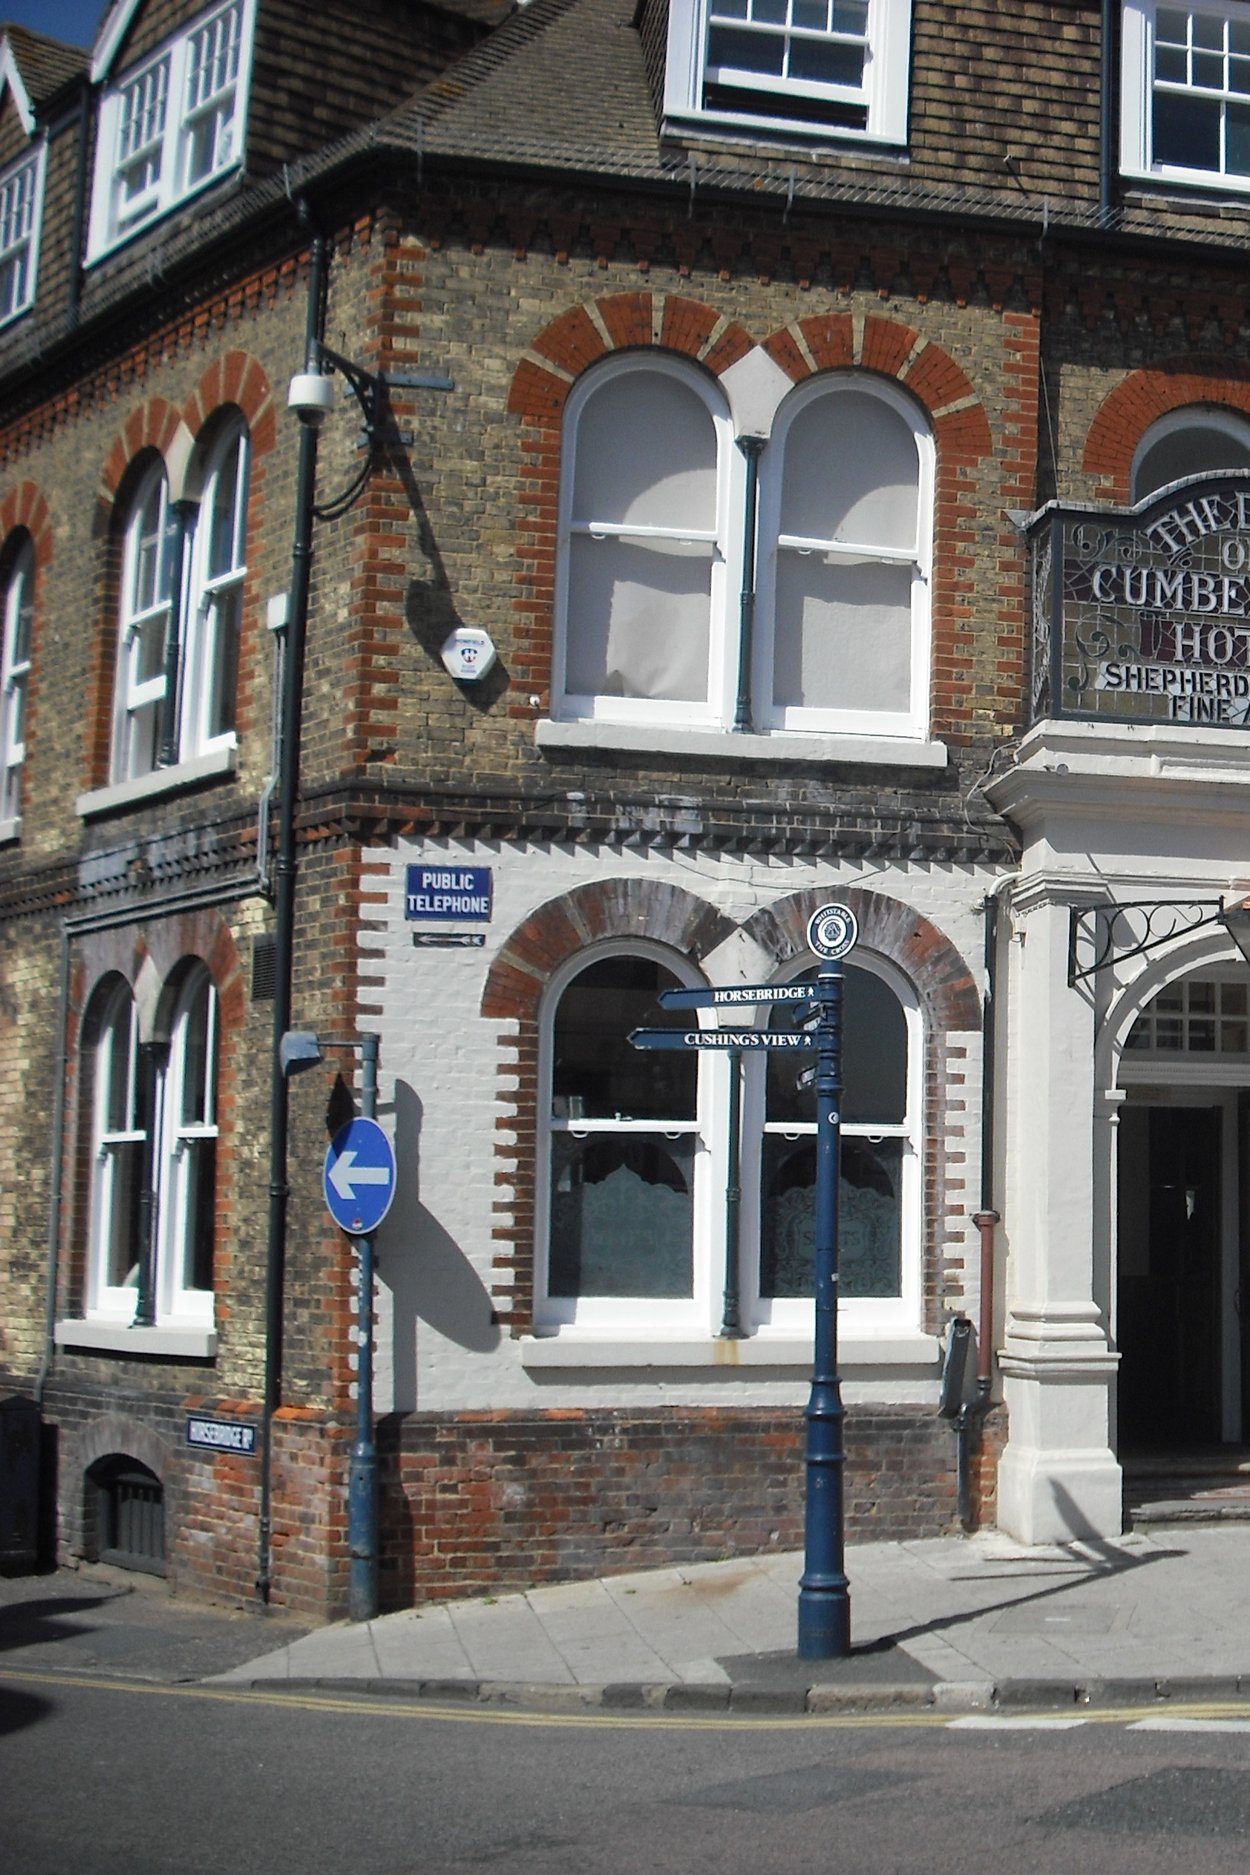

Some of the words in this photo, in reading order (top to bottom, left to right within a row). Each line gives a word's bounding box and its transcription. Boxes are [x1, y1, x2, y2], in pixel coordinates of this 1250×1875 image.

[1145, 494, 1232, 554] THE
[1105, 662, 1250, 698] SHEPHERD
[1172, 696, 1231, 722] FINE
[422, 872, 475, 890] PUBLIC
[407, 894, 490, 914] TELEPHONE
[713, 986, 806, 1003] HORSEBRIDGE
[684, 1032, 759, 1047] CUSHING'S
[760, 1033, 802, 1047] VIEW
